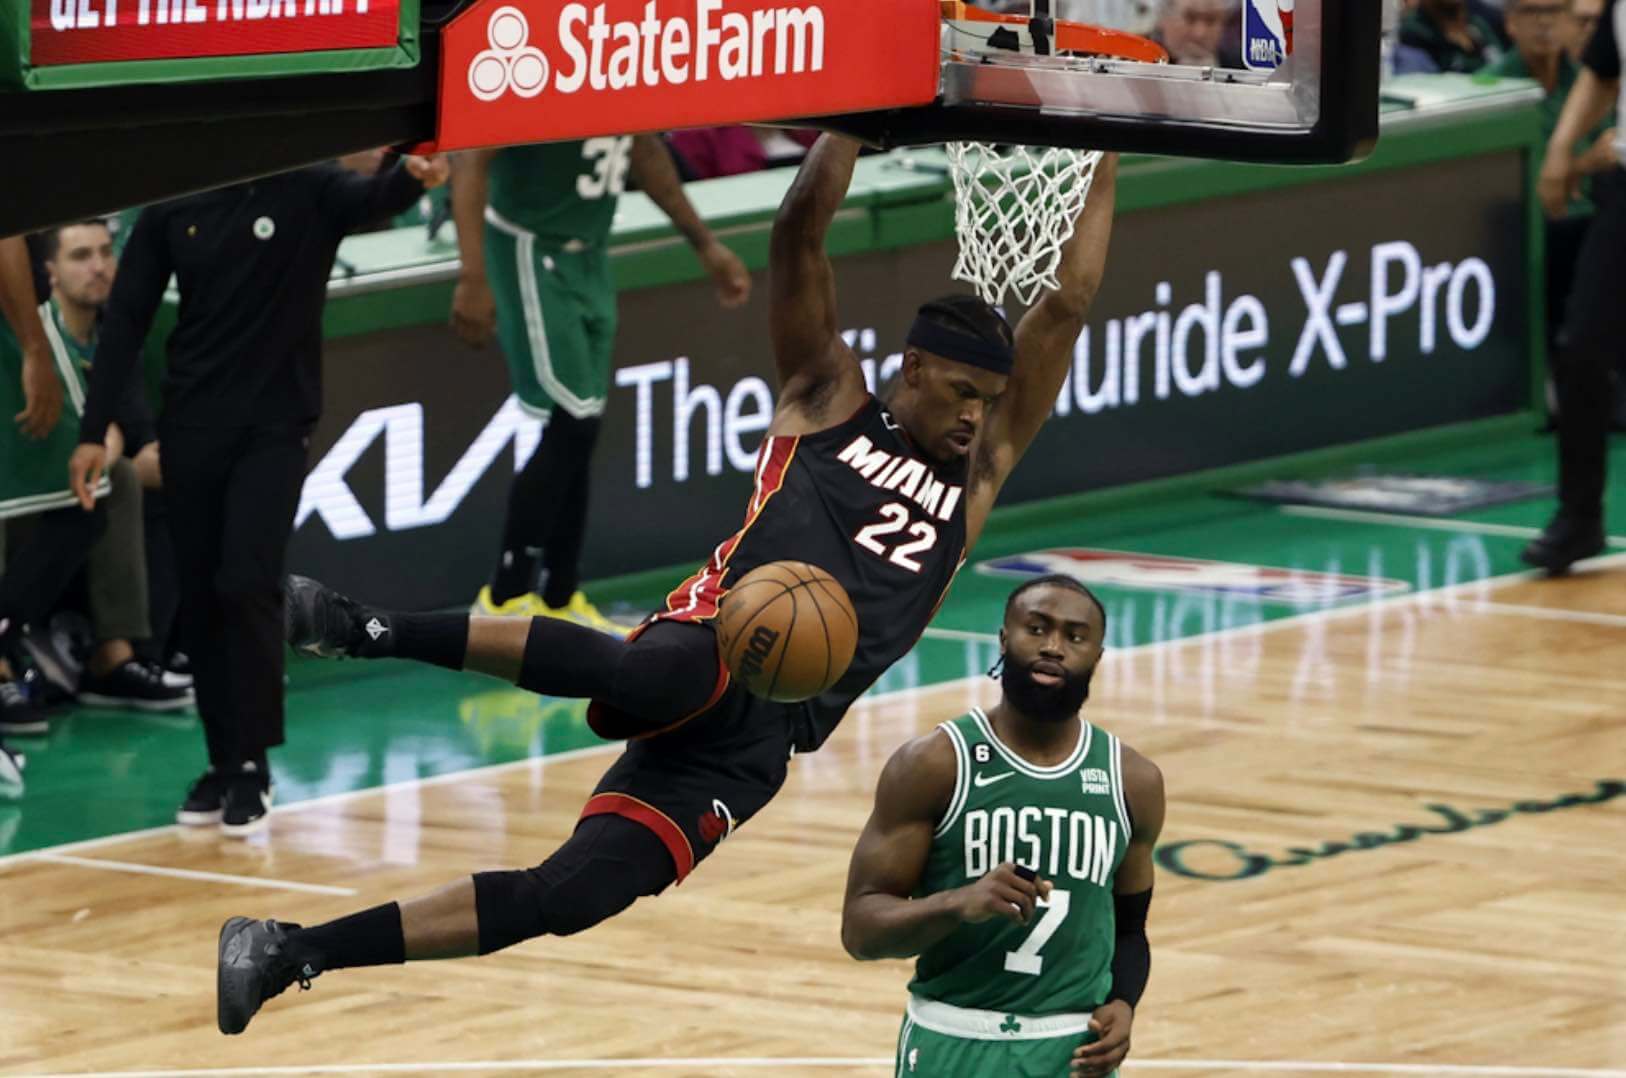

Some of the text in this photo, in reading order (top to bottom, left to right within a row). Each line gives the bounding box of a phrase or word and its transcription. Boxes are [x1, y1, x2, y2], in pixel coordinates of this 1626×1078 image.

[1250, 37, 1276, 62] NBA
[616, 357, 772, 489] The
[1289, 241, 1496, 377] X-Pro
[836, 434, 962, 522] MIAMI
[853, 502, 938, 574] 22
[975, 744, 990, 763] 6
[1080, 767, 1110, 784] VISTA
[1082, 782, 1110, 795] PRINT
[964, 806, 1117, 887] BOSTON
[1003, 888, 1072, 977] 7
